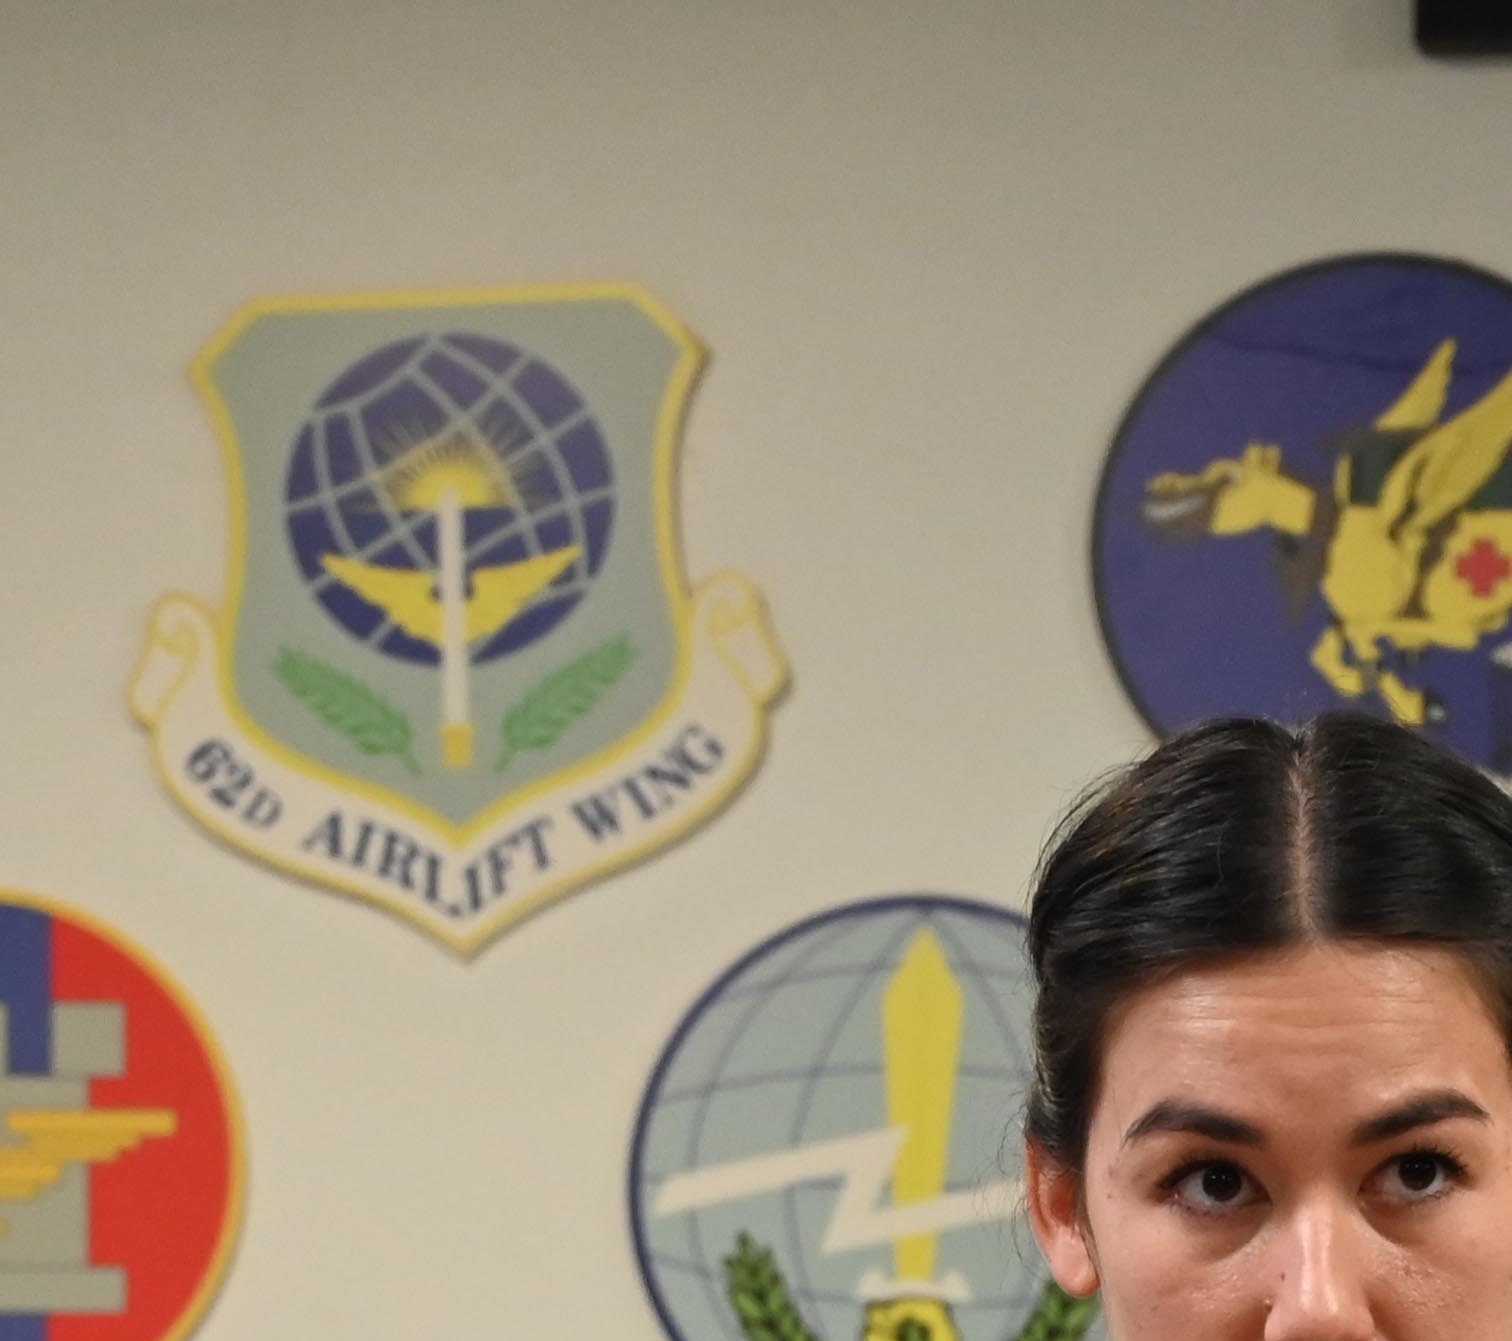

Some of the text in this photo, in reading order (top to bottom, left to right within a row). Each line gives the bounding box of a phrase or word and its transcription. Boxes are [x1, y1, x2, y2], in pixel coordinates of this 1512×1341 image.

[184, 723, 725, 919] 62D AIRLIFT WING
